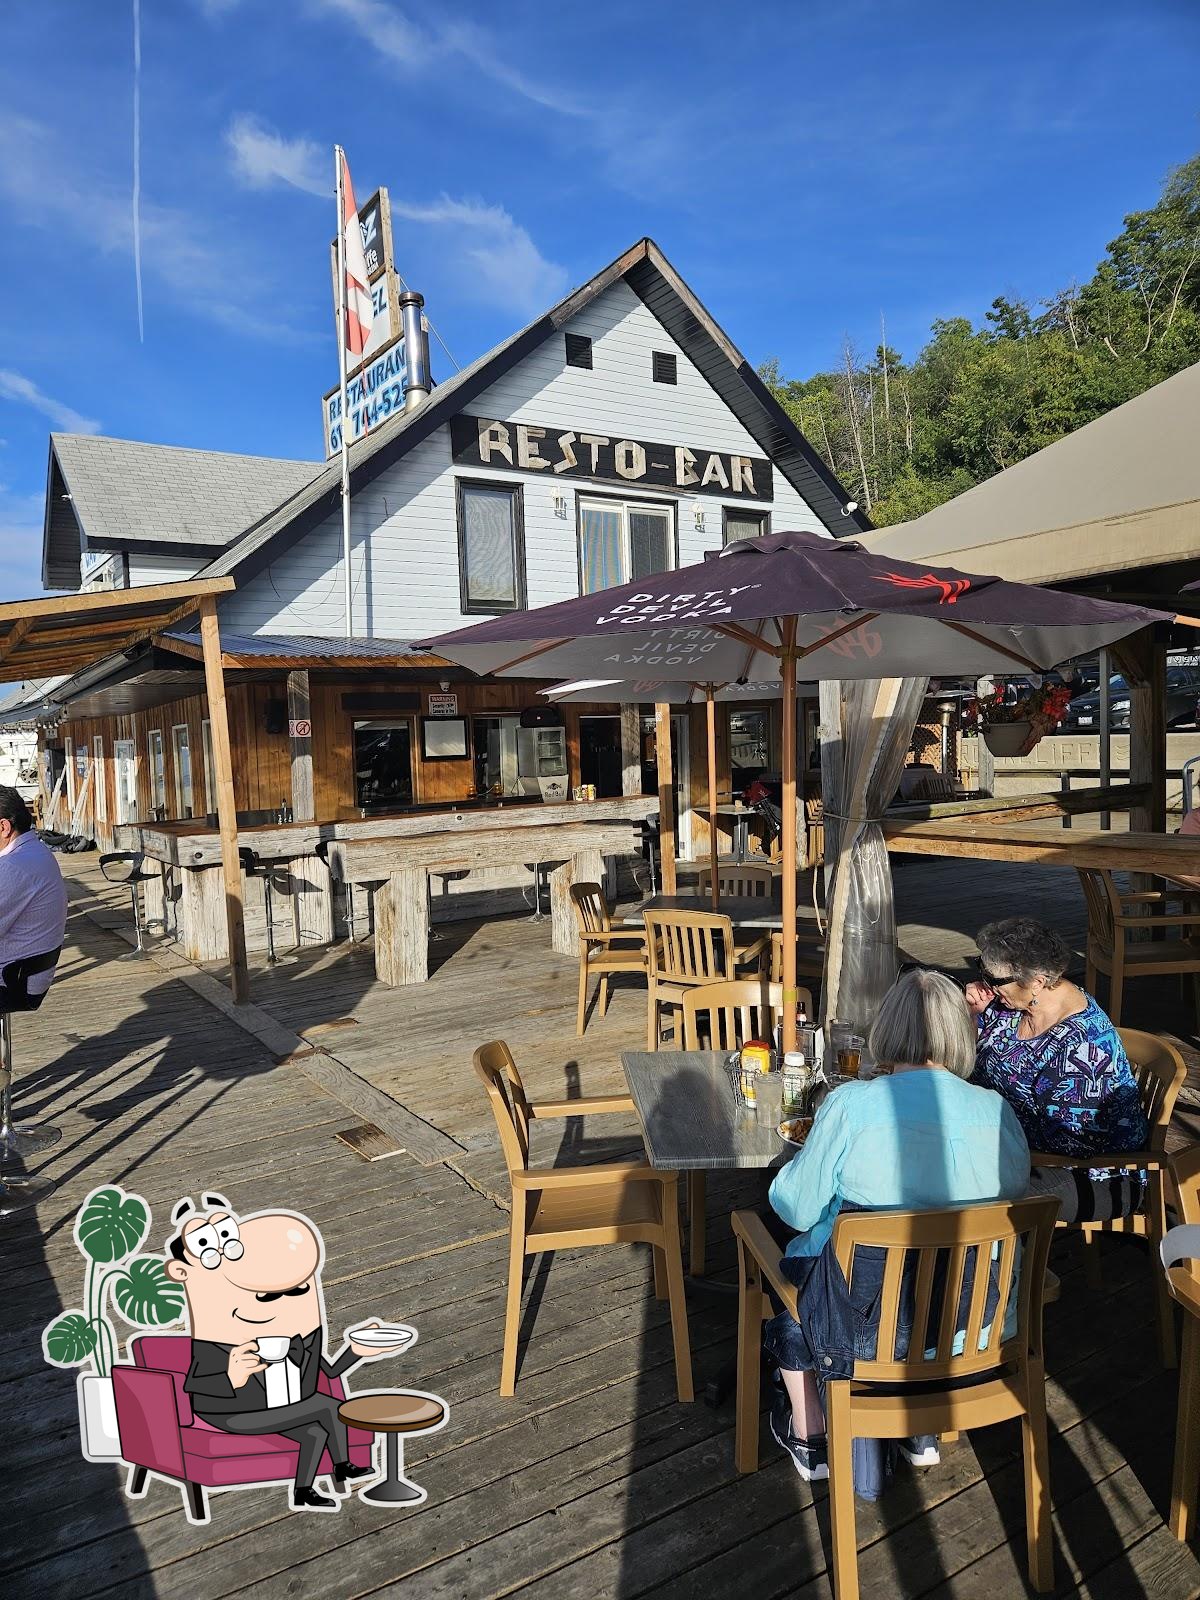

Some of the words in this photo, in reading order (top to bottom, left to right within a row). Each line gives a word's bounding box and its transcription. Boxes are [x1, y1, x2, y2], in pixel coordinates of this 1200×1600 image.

[329, 344, 406, 422] RETAURAN
[477, 417, 758, 495] RESTO-BAR
[628, 584, 752, 603] DIRTY
[596, 606, 732, 625] VODKA
[610, 598, 727, 614] DEVIL
